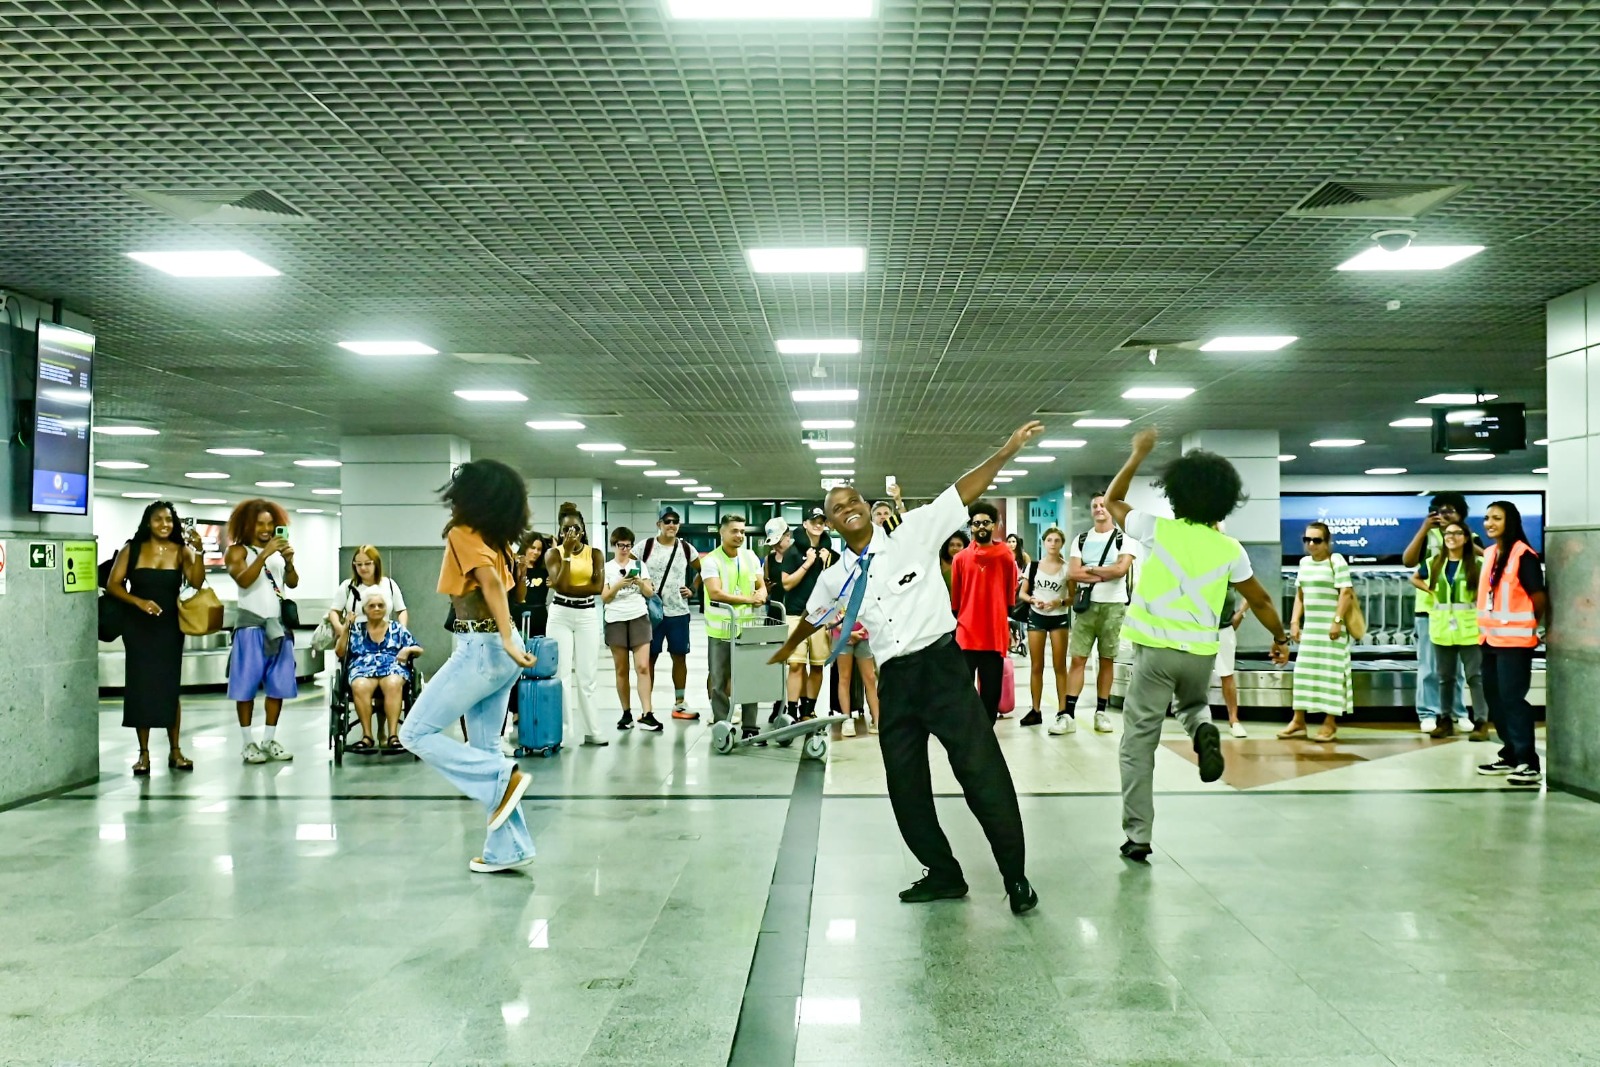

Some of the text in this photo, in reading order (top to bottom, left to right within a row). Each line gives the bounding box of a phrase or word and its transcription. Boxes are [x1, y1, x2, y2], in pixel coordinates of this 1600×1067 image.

[1368, 518, 1399, 526] BAHIA
[1328, 526, 1361, 534] RPORT
[1037, 580, 1062, 592] APRI
